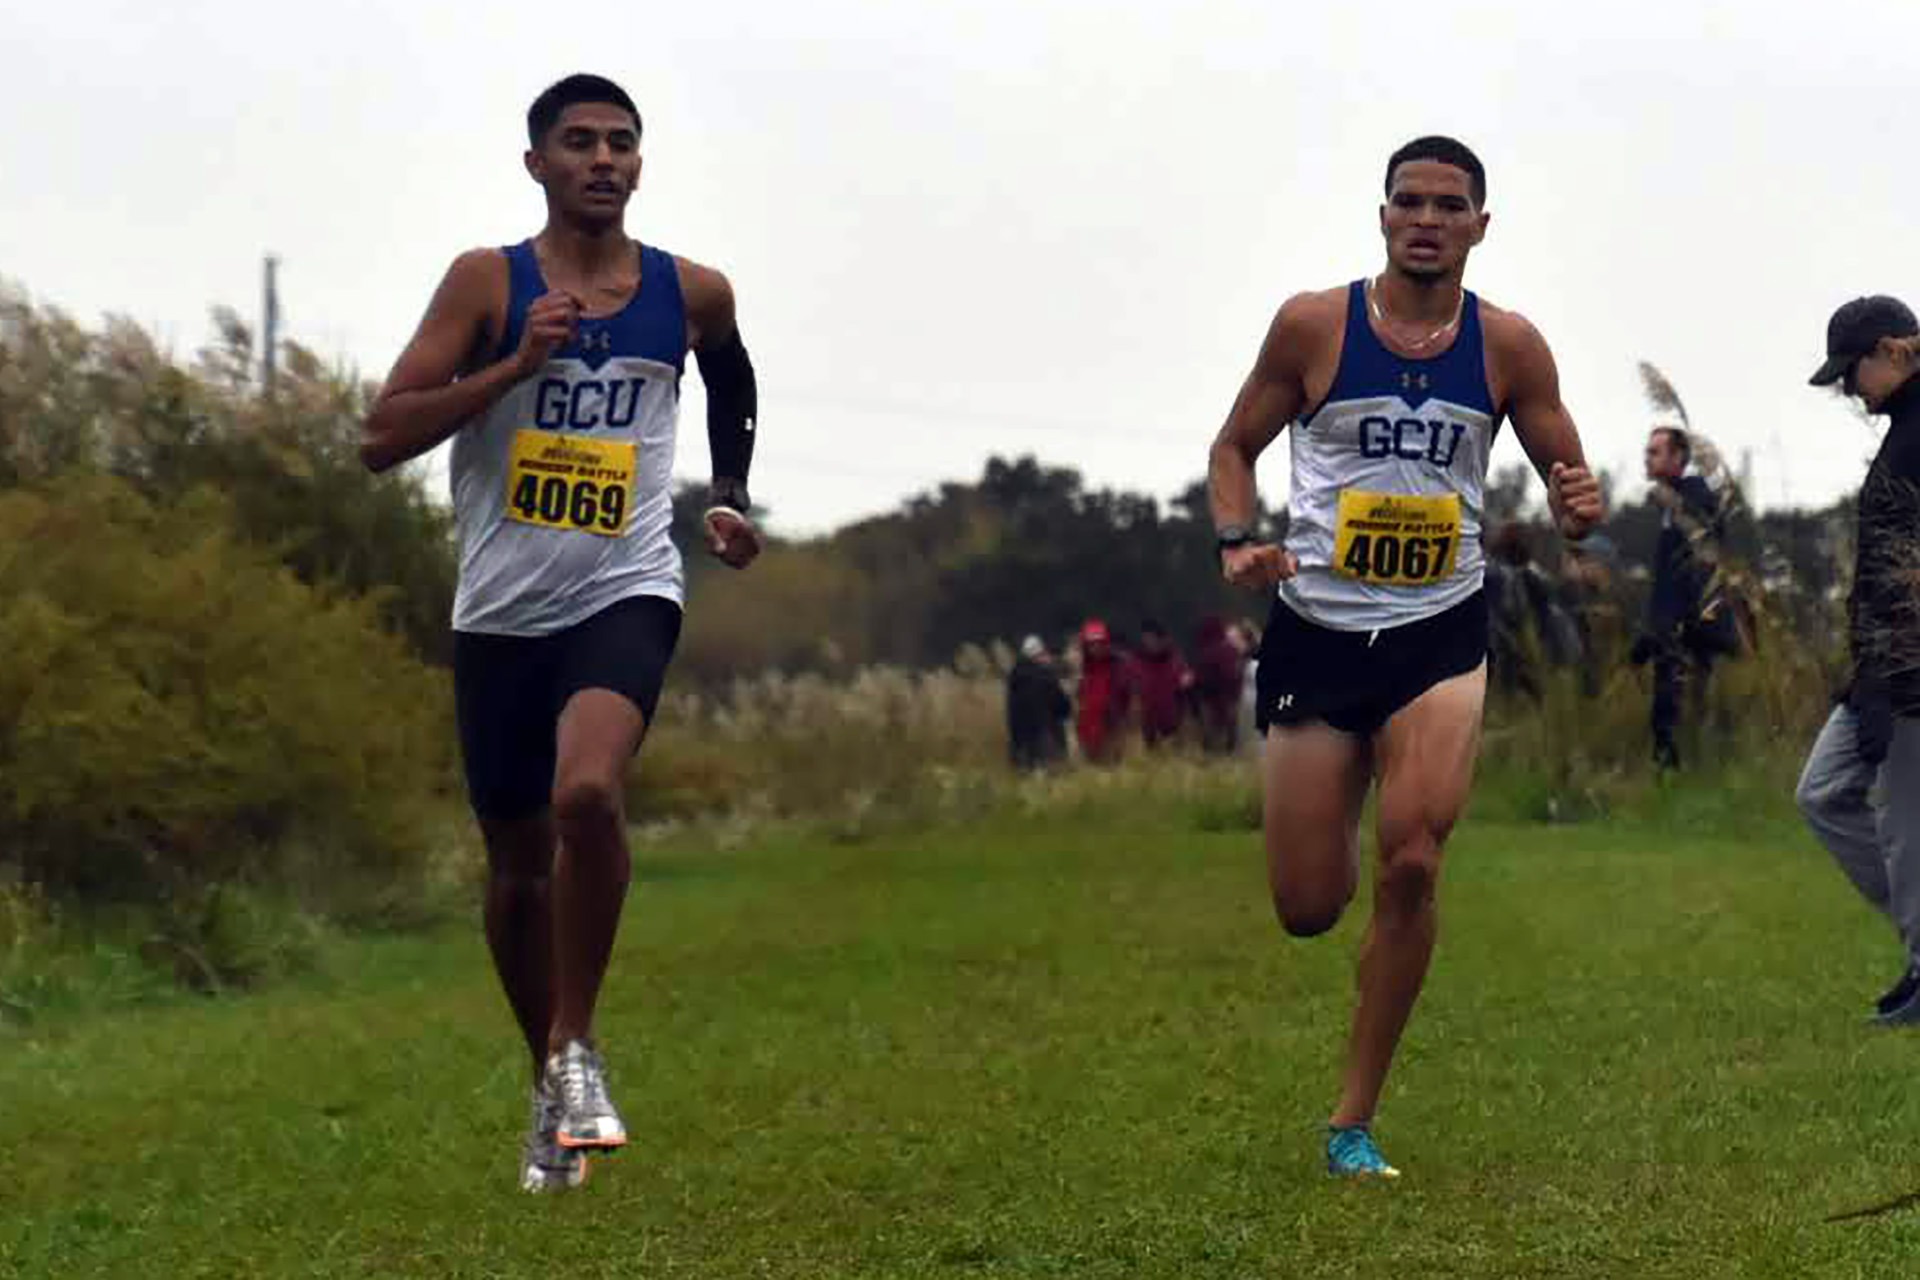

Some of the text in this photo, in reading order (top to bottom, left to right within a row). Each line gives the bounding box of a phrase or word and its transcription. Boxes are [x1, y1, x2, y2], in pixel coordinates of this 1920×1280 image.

[534, 378, 646, 429] GCU
[1359, 416, 1466, 467] GCU
[512, 474, 625, 530] 4069
[1343, 534, 1451, 579] 4067
